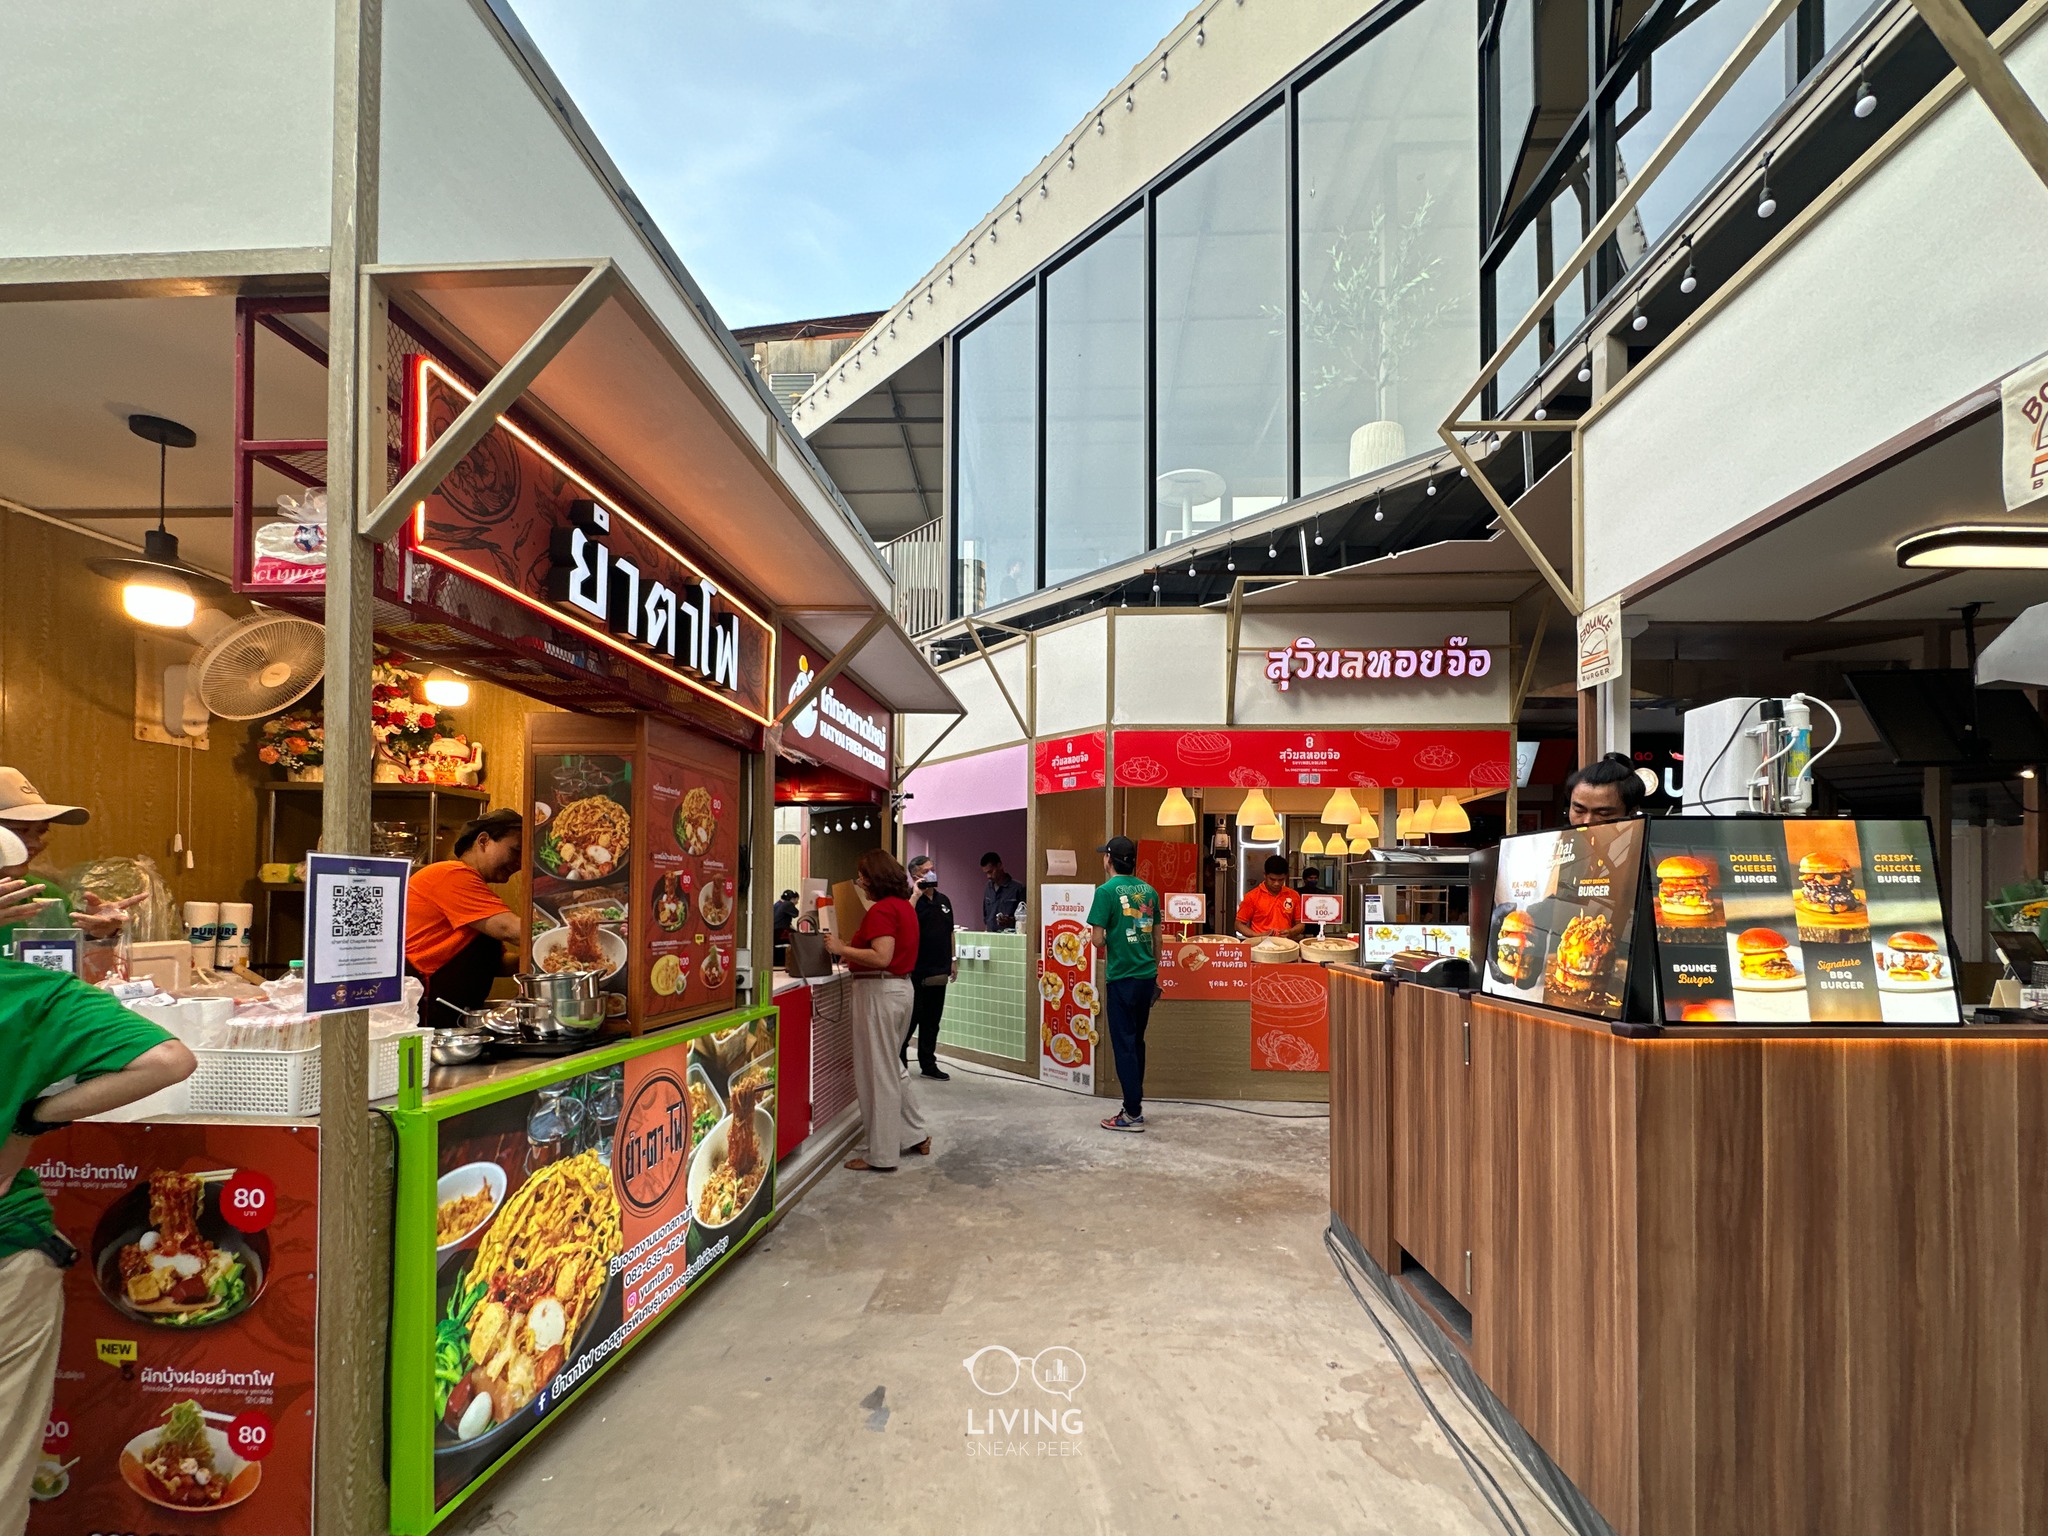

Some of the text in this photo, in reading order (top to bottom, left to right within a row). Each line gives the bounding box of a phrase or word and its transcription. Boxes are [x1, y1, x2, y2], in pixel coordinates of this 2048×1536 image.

[568, 502, 739, 692] ยำตาโฟ
[1580, 614, 1613, 643] BOUNCE
[1265, 636, 1492, 691] สุวิมลหอยจ๊อ
[1582, 668, 1610, 682] BURGER
[1279, 748, 1341, 763] สุวิมลหอยจ๊อ
[1729, 854, 1776, 862] DOUBLE-
[1873, 854, 1918, 862] CRISPY-
[1732, 864, 1777, 873] CHEESE!
[1873, 864, 1922, 872] CHICKIE
[1734, 875, 1778, 883] BURGER
[1877, 875, 1921, 883] BURGER
[1577, 885, 1610, 897] BURGER
[1673, 964, 1717, 972] BOUNCE
[1817, 958, 1861, 972] Signature
[1678, 973, 1714, 987] Burger
[1830, 971, 1853, 980] BBQ
[1820, 981, 1864, 989] BURGER
[233, 1188, 265, 1208] 80
[623, 1230, 686, 1289] 082-635-4624
[638, 1263, 674, 1304] yumtafo
[101, 1344, 131, 1355] NEW
[140, 1366, 275, 1388] ผักบุ้งฝอยยำตาโฟ
[551, 1347, 596, 1400] ยำตาโฟ
[45, 1421, 69, 1438] 00
[238, 1426, 266, 1444] 80
